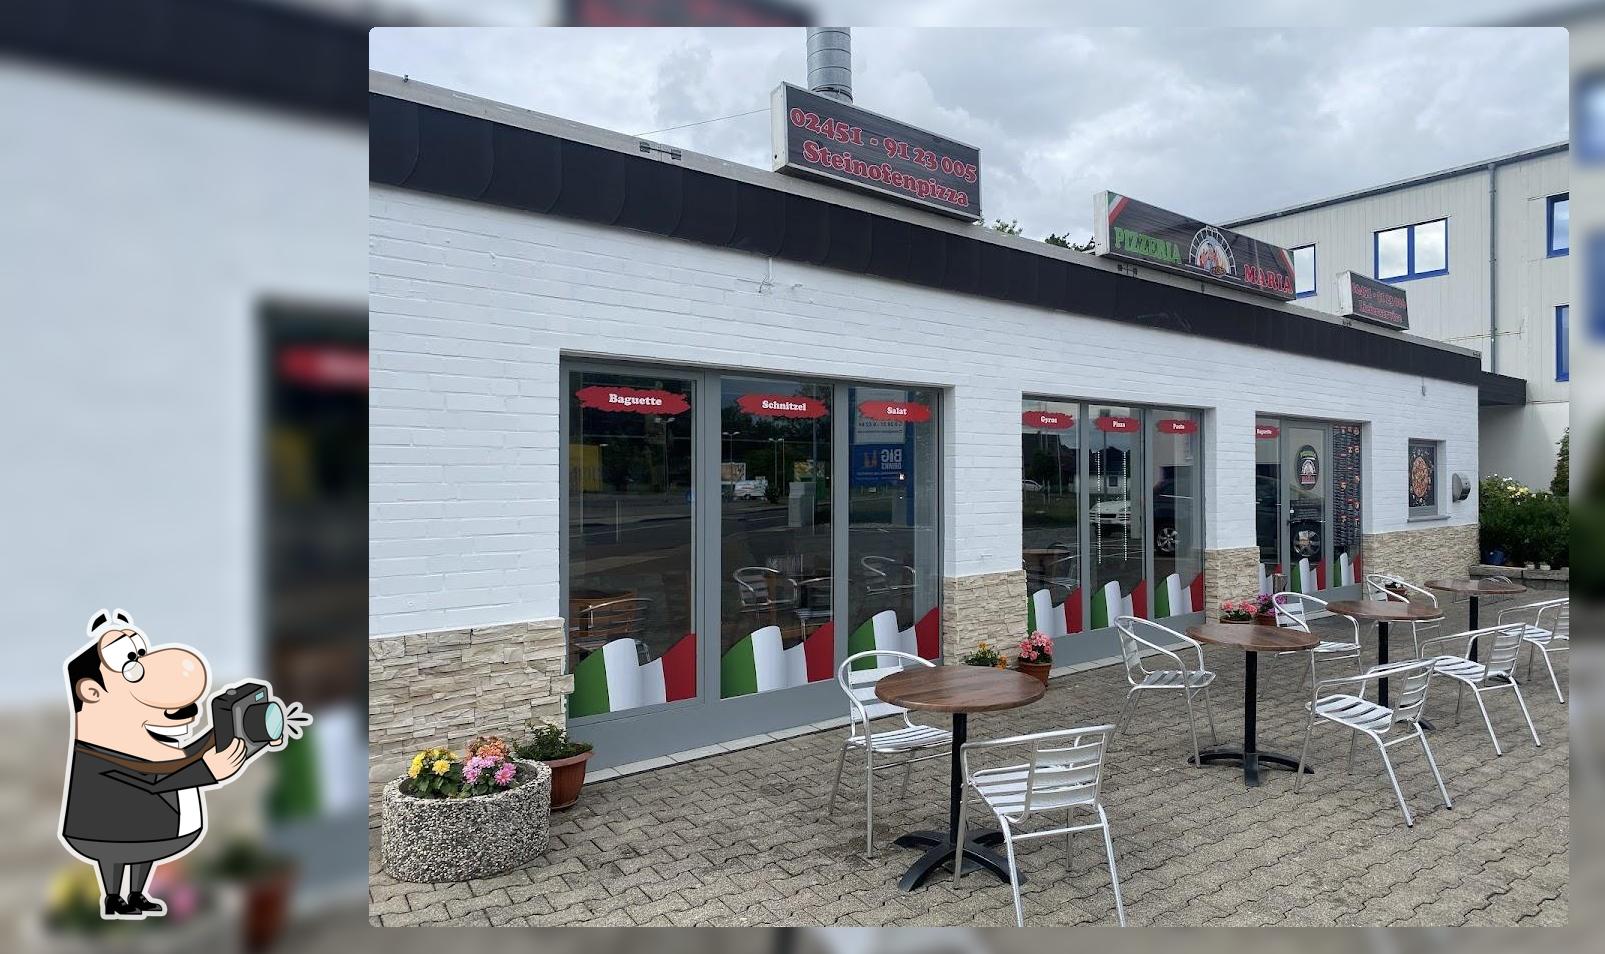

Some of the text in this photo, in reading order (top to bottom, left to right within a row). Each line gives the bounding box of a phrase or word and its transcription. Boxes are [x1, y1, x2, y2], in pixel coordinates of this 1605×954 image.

[790, 107, 977, 183] 02451 - 91 23 005
[803, 140, 969, 207] Steinofenpizza
[1114, 226, 1183, 264] PIZZERIA
[1244, 263, 1294, 294] MARIA
[608, 393, 663, 406] Baguette
[762, 400, 807, 412] Schnitzel
[886, 406, 908, 415] Salat
[1040, 415, 1058, 424] Gyros
